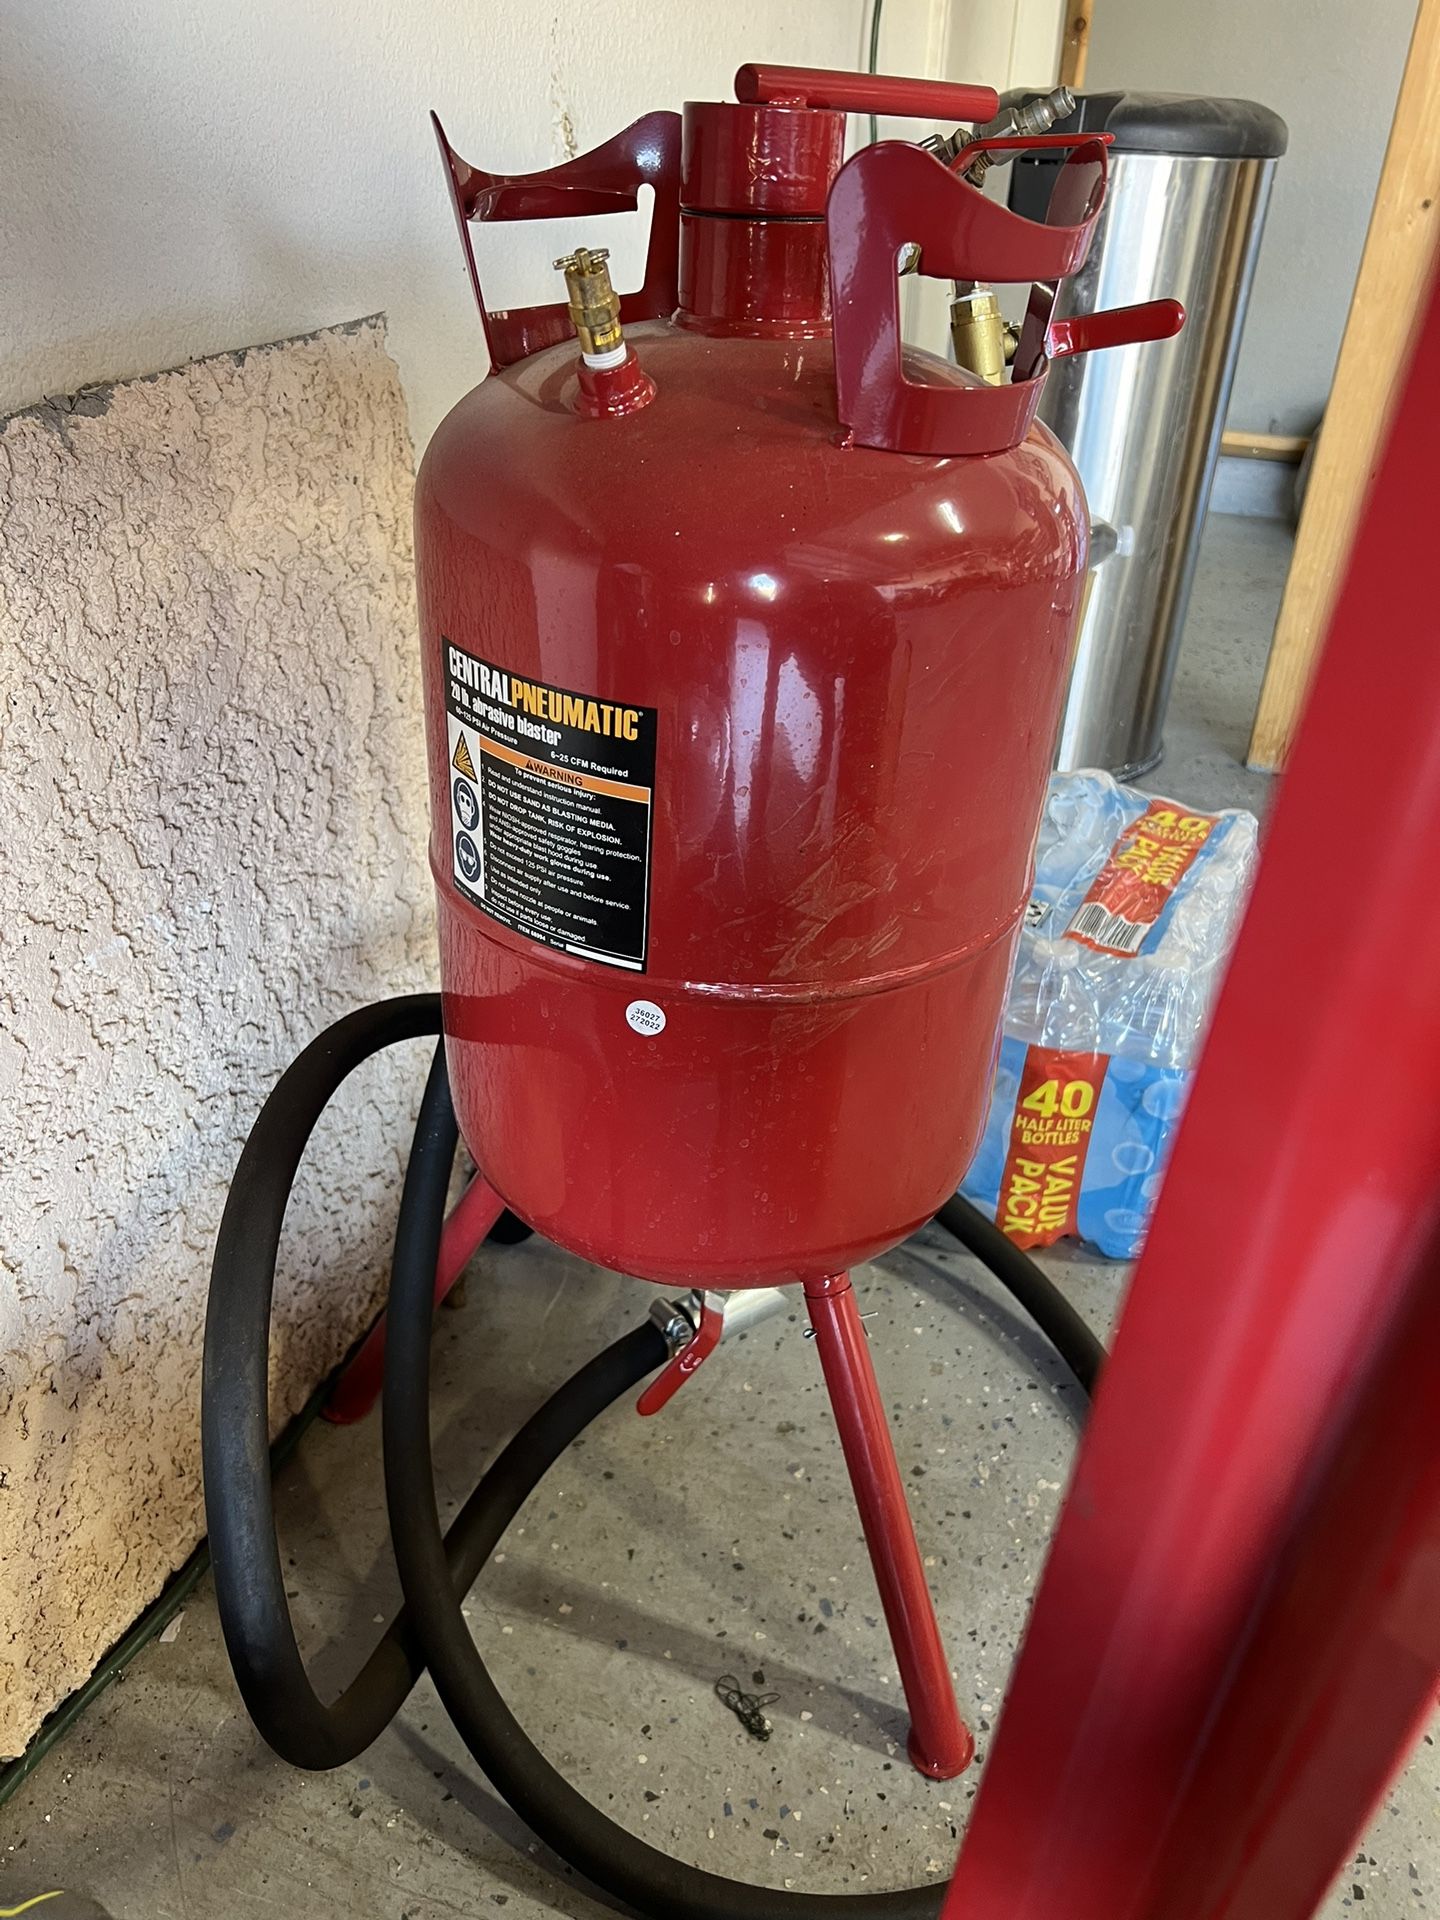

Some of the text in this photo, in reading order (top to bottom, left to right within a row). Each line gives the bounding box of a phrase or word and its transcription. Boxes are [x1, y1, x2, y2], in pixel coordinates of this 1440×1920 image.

[472, 696, 515, 730] abrasive
[516, 714, 562, 746] blaster
[482, 721, 490, 732] Air
[490, 726, 519, 745] Pressure
[533, 762, 583, 787] WARNING
[550, 750, 629, 778] 6-25 CFM Required
[487, 766, 501, 778] Read
[501, 773, 511, 784] and
[511, 778, 543, 797] understand
[543, 790, 575, 808] instruction
[514, 767, 597, 801] To prevent serious injury:
[487, 779, 497, 789] DO
[496, 783, 509, 793] NOT
[509, 789, 522, 801] USE
[522, 796, 541, 809] SAND
[541, 803, 551, 813] AS
[552, 807, 588, 824] BLASTING
[589, 818, 616, 831] MEDIA.
[488, 791, 497, 801] DO
[497, 797, 509, 807] NOT
[509, 802, 527, 815] DROP
[547, 818, 565, 830] RISK
[565, 824, 576, 833] OF
[576, 827, 623, 846] EXPLOSION.
[1143, 810, 1210, 832] 40
[533, 841, 547, 854] blast
[547, 847, 564, 859] hood
[563, 854, 584, 868] during
[537, 836, 556, 849] safety
[556, 843, 582, 857] goggles
[579, 841, 605, 855] hearing
[525, 859, 536, 869] 125
[536, 864, 547, 874] PSI
[547, 869, 556, 877] air
[533, 852, 549, 863] work
[549, 858, 572, 871] gloves
[572, 866, 595, 880] during
[542, 880, 557, 889] after
[557, 884, 569, 894] use
[569, 889, 582, 899] and
[582, 892, 604, 905] before
[544, 903, 564, 916] people
[564, 910, 572, 918] or
[1022, 1079, 1094, 1118] 40
[1015, 1114, 1092, 1133] HALF LITER
[1021, 1130, 1080, 1146] BOTTLES
[1003, 1157, 1046, 1233] PACK
[1035, 1155, 1078, 1234] VALUE
